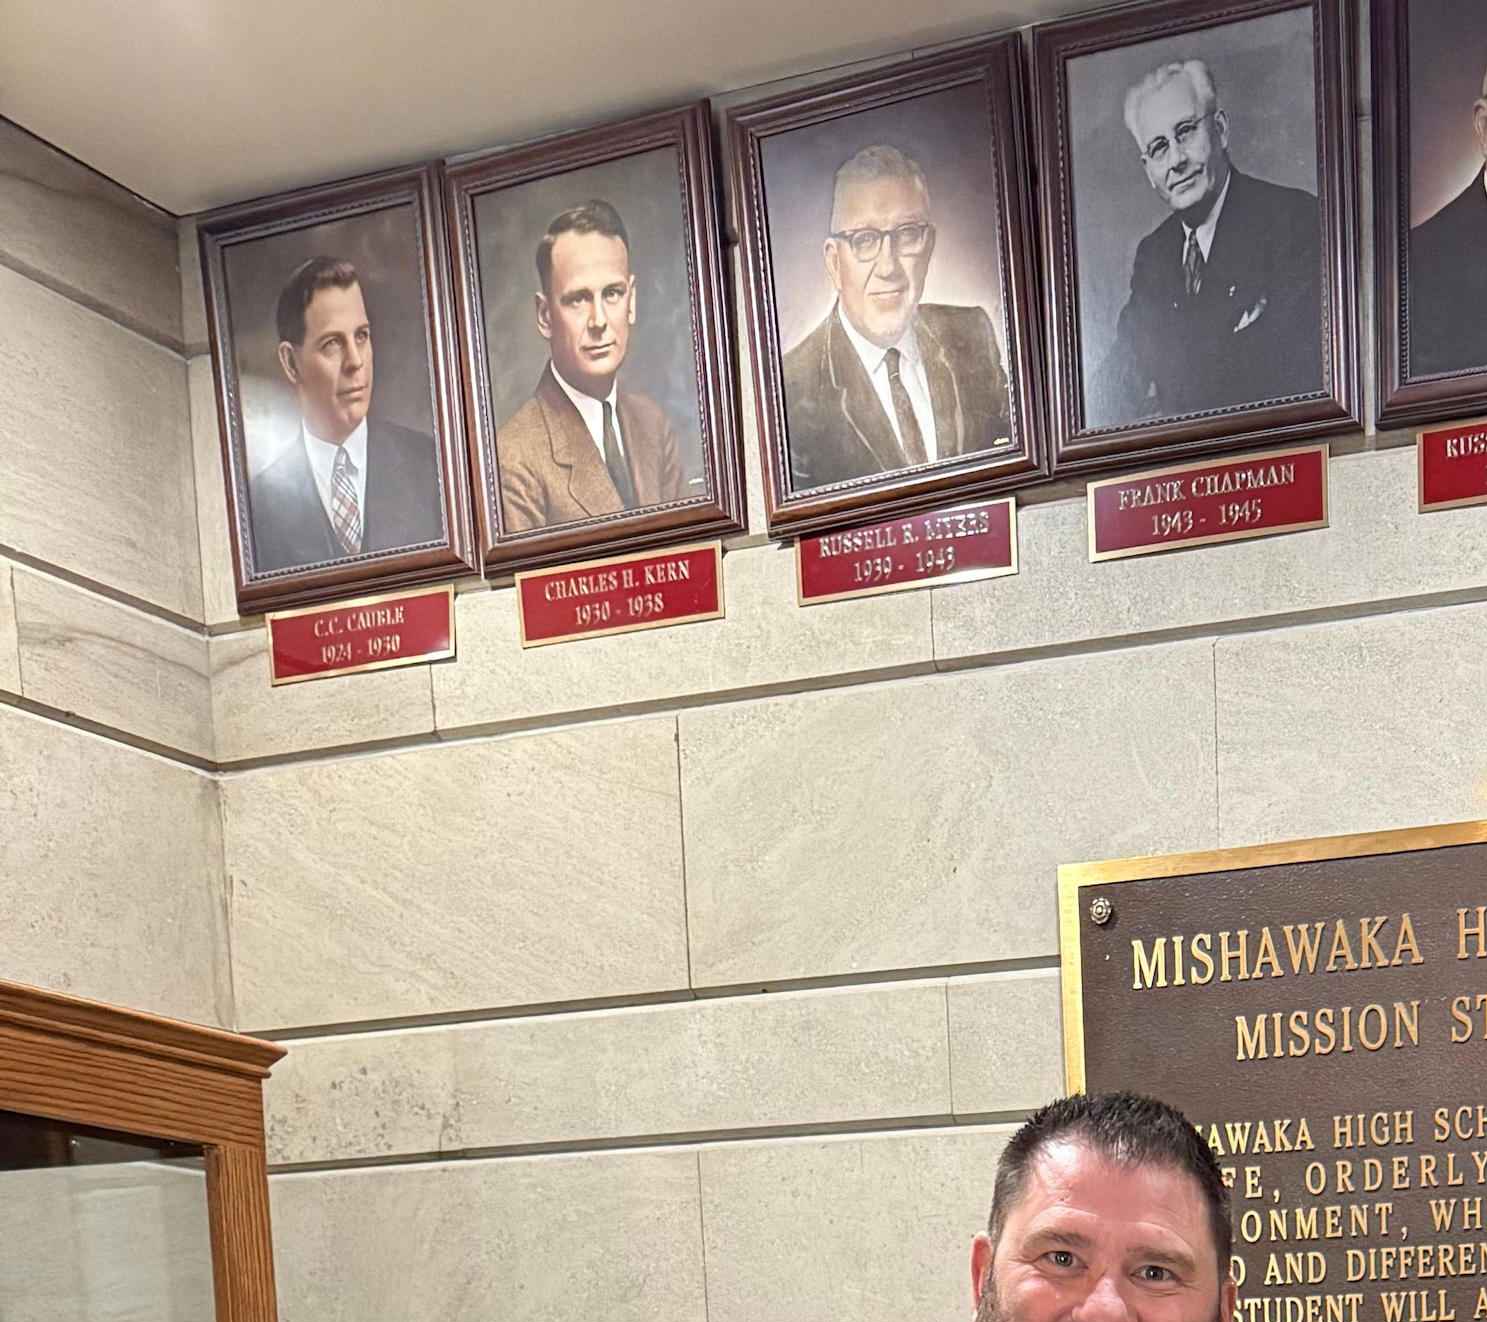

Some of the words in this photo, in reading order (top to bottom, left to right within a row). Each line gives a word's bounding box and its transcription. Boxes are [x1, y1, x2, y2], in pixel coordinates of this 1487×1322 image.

[1119, 480, 1186, 510] FRANK
[1191, 463, 1295, 497] CHAPMAN
[1152, 510, 1194, 536] 1943
[1219, 499, 1262, 526] 1945
[819, 527, 896, 559] RUSSELL
[545, 571, 618, 601] CHARLES
[621, 568, 640, 588] H.
[644, 560, 690, 585] KERN
[854, 556, 892, 582] 1939
[575, 601, 611, 625] 1930
[627, 592, 665, 617] 1938
[321, 642, 351, 665] 1924
[368, 634, 400, 657] 1930
[1131, 913, 1424, 992] MISHAWAKA
[1234, 1002, 1421, 1062] MISSION
[1195, 1118, 1315, 1156] AWAKA
[1333, 1110, 1415, 1148] HIGH
[1232, 1202, 1409, 1243] ONMENT,
[1264, 1251, 1327, 1286] AND
